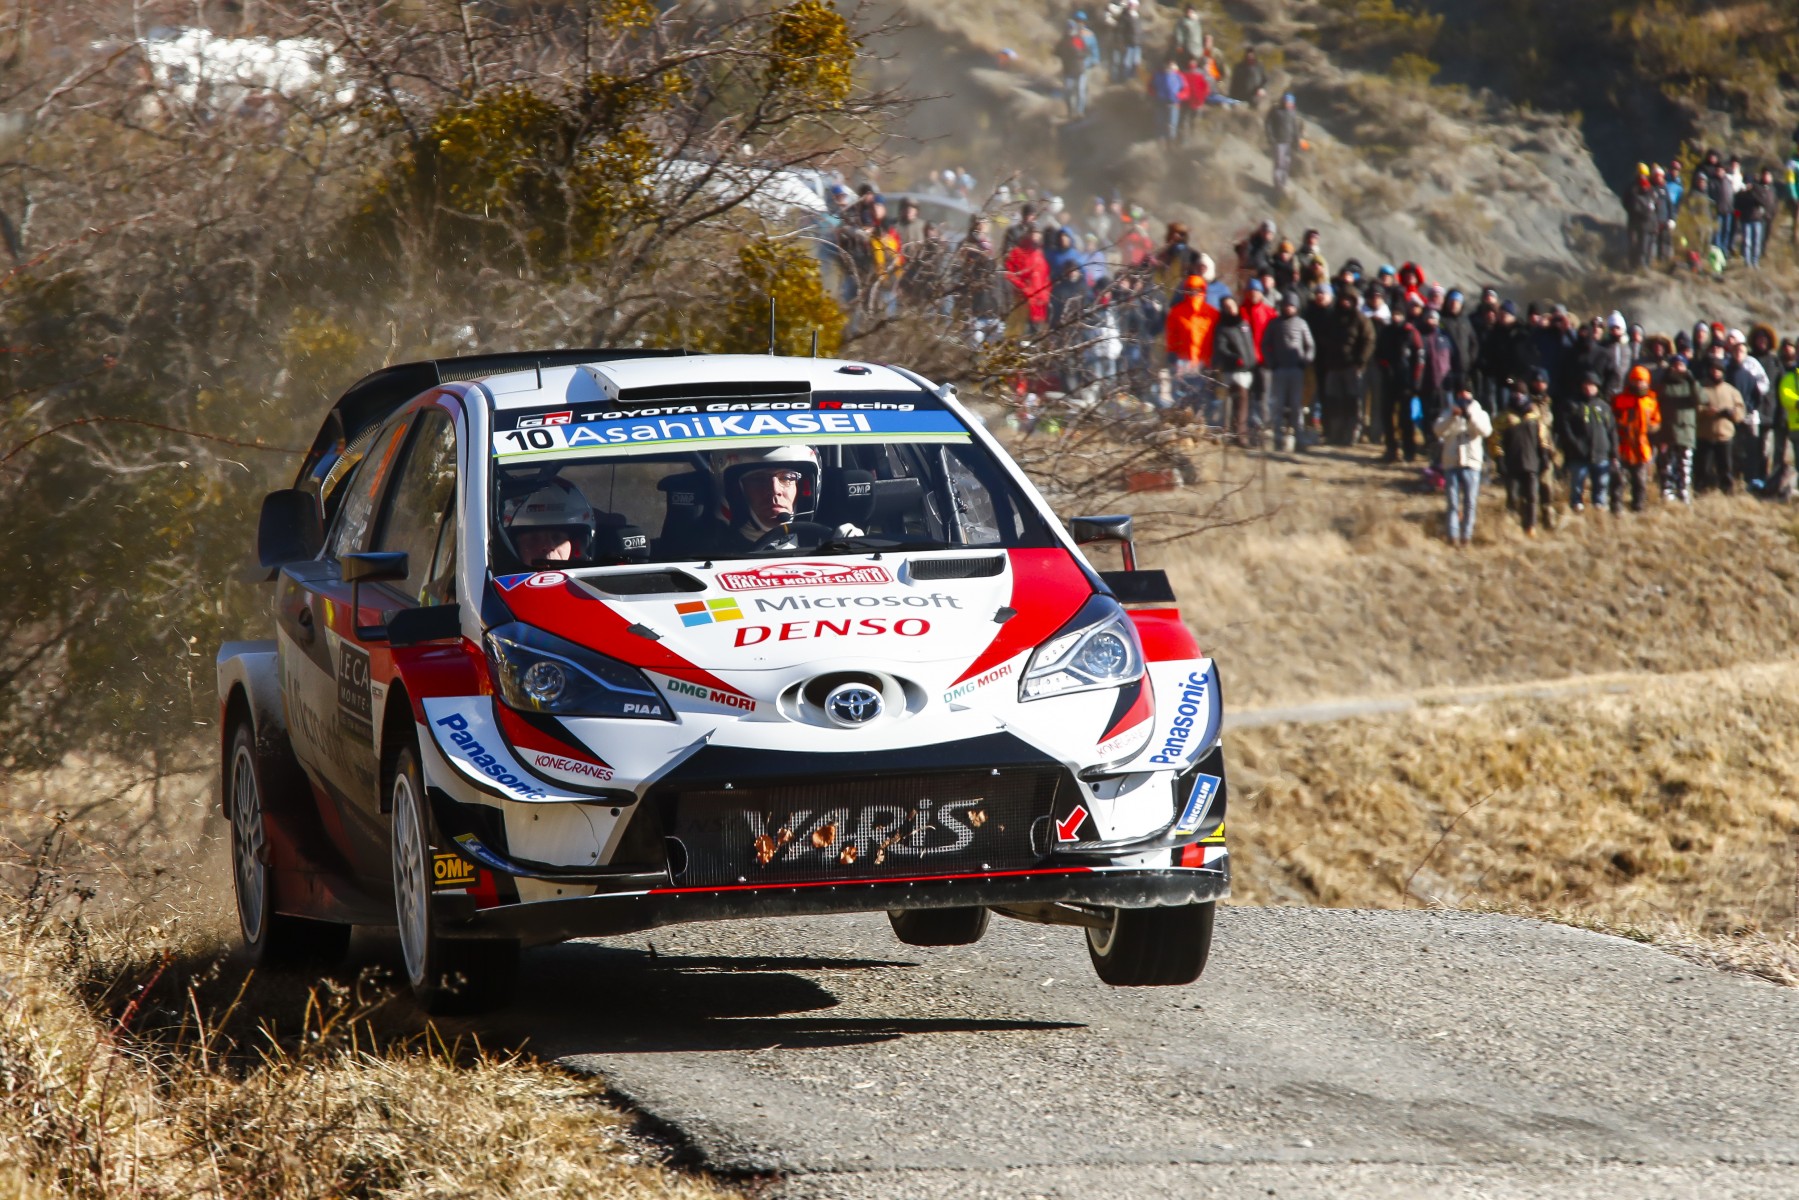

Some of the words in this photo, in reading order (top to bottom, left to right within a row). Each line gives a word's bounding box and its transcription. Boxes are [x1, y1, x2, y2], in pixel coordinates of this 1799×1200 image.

[519, 416, 571, 428] GR
[580, 405, 698, 421] TOYOTA
[706, 401, 811, 413] GAZOO
[818, 401, 915, 412] Racing
[505, 428, 554, 450] 10
[568, 417, 706, 447] Asahi
[707, 412, 872, 436] KASEI
[848, 483, 871, 495] OMP
[623, 537, 646, 548] OMP
[754, 593, 963, 612] Microsoft
[733, 618, 931, 648] DENSO
[667, 679, 707, 699] DMG
[709, 690, 756, 712] MORI
[943, 682, 975, 703] DMG
[977, 664, 1012, 688] MORI
[623, 703, 662, 715] PIAA
[1150, 671, 1209, 765] Panasonic
[436, 713, 547, 800] Panasonic
[535, 755, 613, 781] KONECRANES
[1187, 781, 1211, 824] MICHELIN
